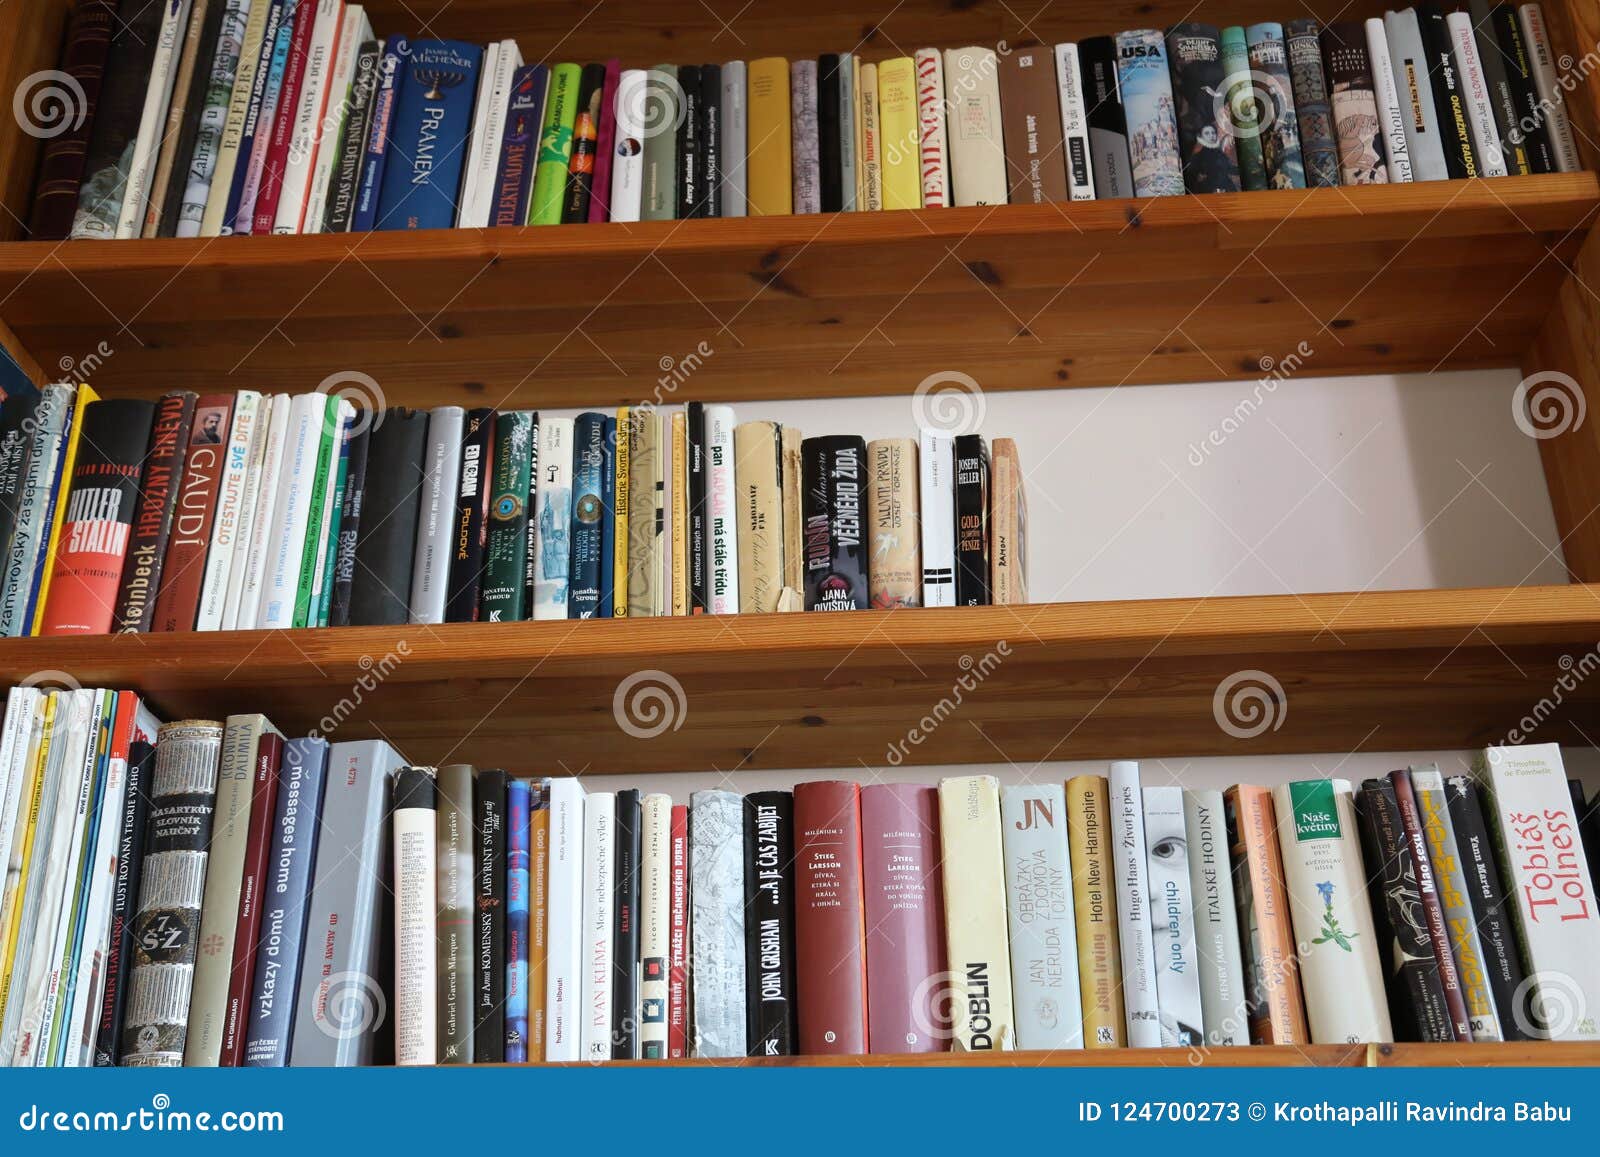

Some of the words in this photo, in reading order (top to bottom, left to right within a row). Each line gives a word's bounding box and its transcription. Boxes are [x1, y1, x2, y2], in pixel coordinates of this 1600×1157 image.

[1120, 45, 1161, 59] USA
[252, 64, 268, 96] RADOST
[412, 108, 445, 185] PRAMEN
[865, 129, 874, 161] humor
[711, 446, 722, 466] pan
[831, 447, 857, 481] ŽIDA
[959, 458, 979, 470] JOSEPH
[24, 461, 40, 508] sedmi
[958, 472, 980, 485] HELLER
[67, 488, 123, 523] HITLER
[136, 464, 171, 537] HROZNY
[175, 449, 216, 547] GAUDÍ
[218, 473, 241, 546] OTESTUJTE
[231, 447, 246, 470] SVÉ
[617, 481, 627, 515] Historie
[714, 518, 727, 534] má
[832, 483, 860, 546] VĚČNÉHO
[961, 515, 979, 529] GOLD
[68, 519, 128, 556] STALIN
[713, 538, 727, 566] stále
[713, 568, 728, 595] třídu
[822, 589, 847, 601] JANA
[126, 766, 140, 798] VŠEHO
[1121, 786, 1135, 804] pes
[124, 799, 137, 835] TEORIE
[156, 816, 201, 827] SLOVNÍK
[281, 766, 304, 844] messages
[1015, 798, 1054, 830] JN
[1302, 811, 1330, 822] Naše
[754, 805, 783, 842] ZABÍJET
[1082, 791, 1098, 855] Hampshire
[1122, 818, 1136, 848] Život
[1198, 806, 1214, 864] HODINY
[1297, 822, 1339, 834] květiny
[674, 837, 683, 866] DOBRA
[755, 844, 779, 867] ČAS
[1413, 834, 1426, 862] sexu
[115, 837, 133, 911] ILUSTROVANÁ
[276, 847, 296, 893] home
[482, 848, 493, 896] LABYRINT
[809, 861, 841, 870] LARSSON
[887, 864, 920, 872] LARSSON
[1032, 849, 1050, 910] DOMOVA
[1087, 859, 1101, 886] New
[1126, 857, 1138, 887] Haas
[1419, 864, 1434, 893] Mao
[1470, 836, 1483, 861] Yann
[1477, 862, 1493, 899] Martel
[1510, 812, 1558, 923] Tobiáš
[1544, 809, 1590, 922] Lolness
[1014, 856, 1035, 924] OBRÁZKY
[1088, 890, 1103, 923] Hotel
[1130, 889, 1142, 921] Hugo
[1202, 867, 1221, 922] ITALSKÉ
[1166, 881, 1180, 938] children
[1429, 906, 1445, 936] Kuras
[266, 909, 285, 957] domů
[480, 912, 491, 970] KOMENSKÝ
[760, 919, 781, 969] GRISHAM
[593, 940, 606, 984] KLÍMA
[1030, 959, 1045, 987] JAN
[1044, 927, 1062, 988] NERUDA
[1169, 943, 1187, 974] only
[1437, 939, 1457, 990] Benjamin
[101, 977, 117, 1030] STEPHEN
[259, 961, 281, 1018] vzkazy
[761, 972, 786, 1002] JOHN
[447, 1002, 457, 1035] Gabriel
[593, 990, 606, 1026] IVAN
[966, 962, 993, 1050] DÖBLIN
